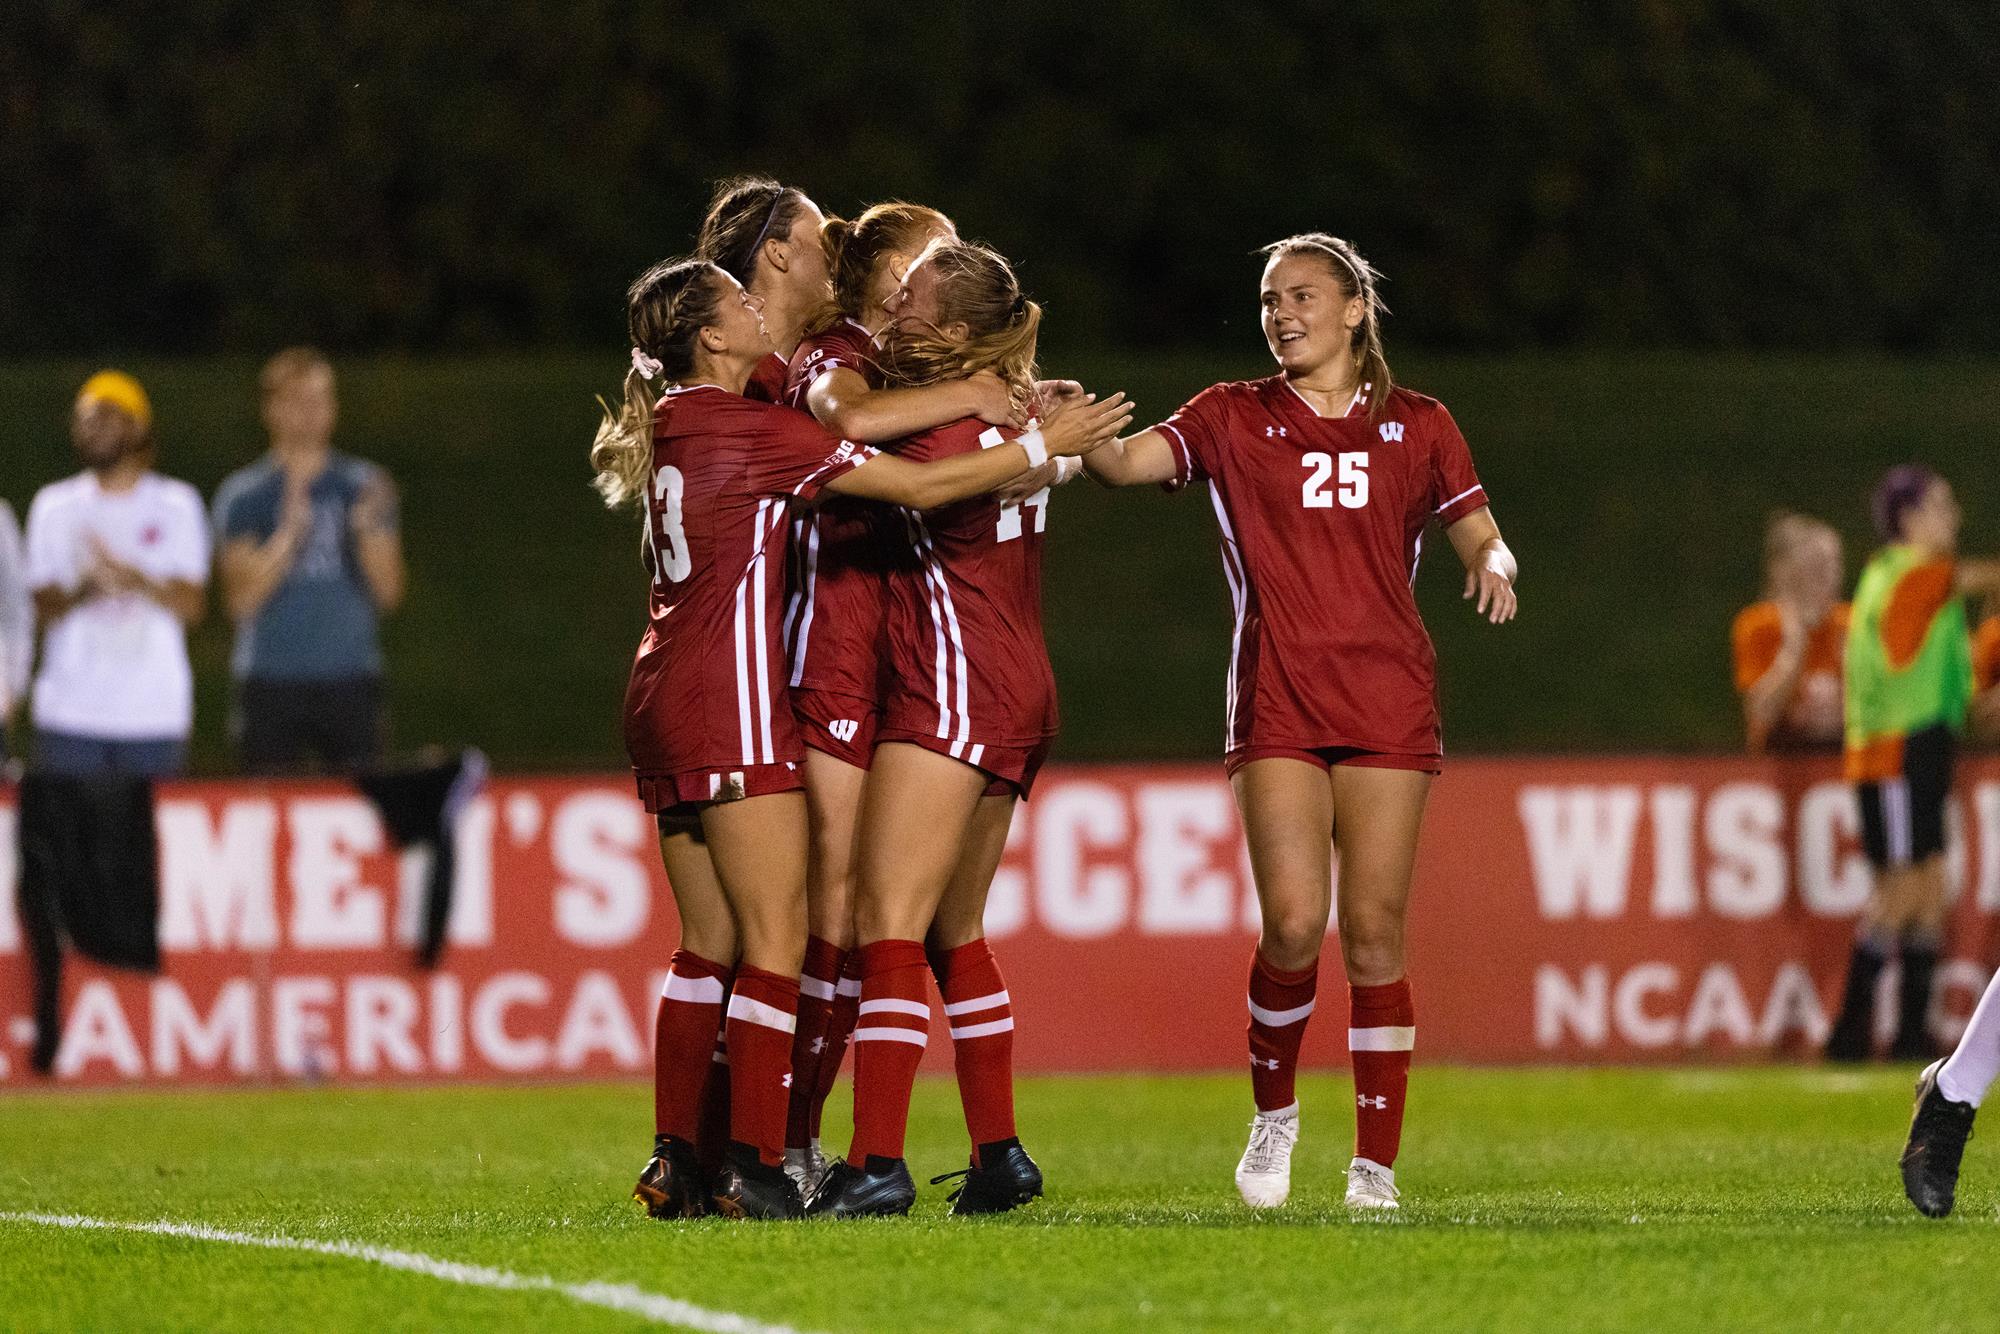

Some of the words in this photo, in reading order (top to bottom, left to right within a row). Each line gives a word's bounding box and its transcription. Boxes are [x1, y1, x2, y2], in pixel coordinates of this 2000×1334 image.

[1378, 421, 1405, 443] W
[1301, 451, 1370, 509] 25
[642, 465, 692, 585] 3
[828, 719, 859, 743] W
[1515, 780, 2000, 920] WISC
